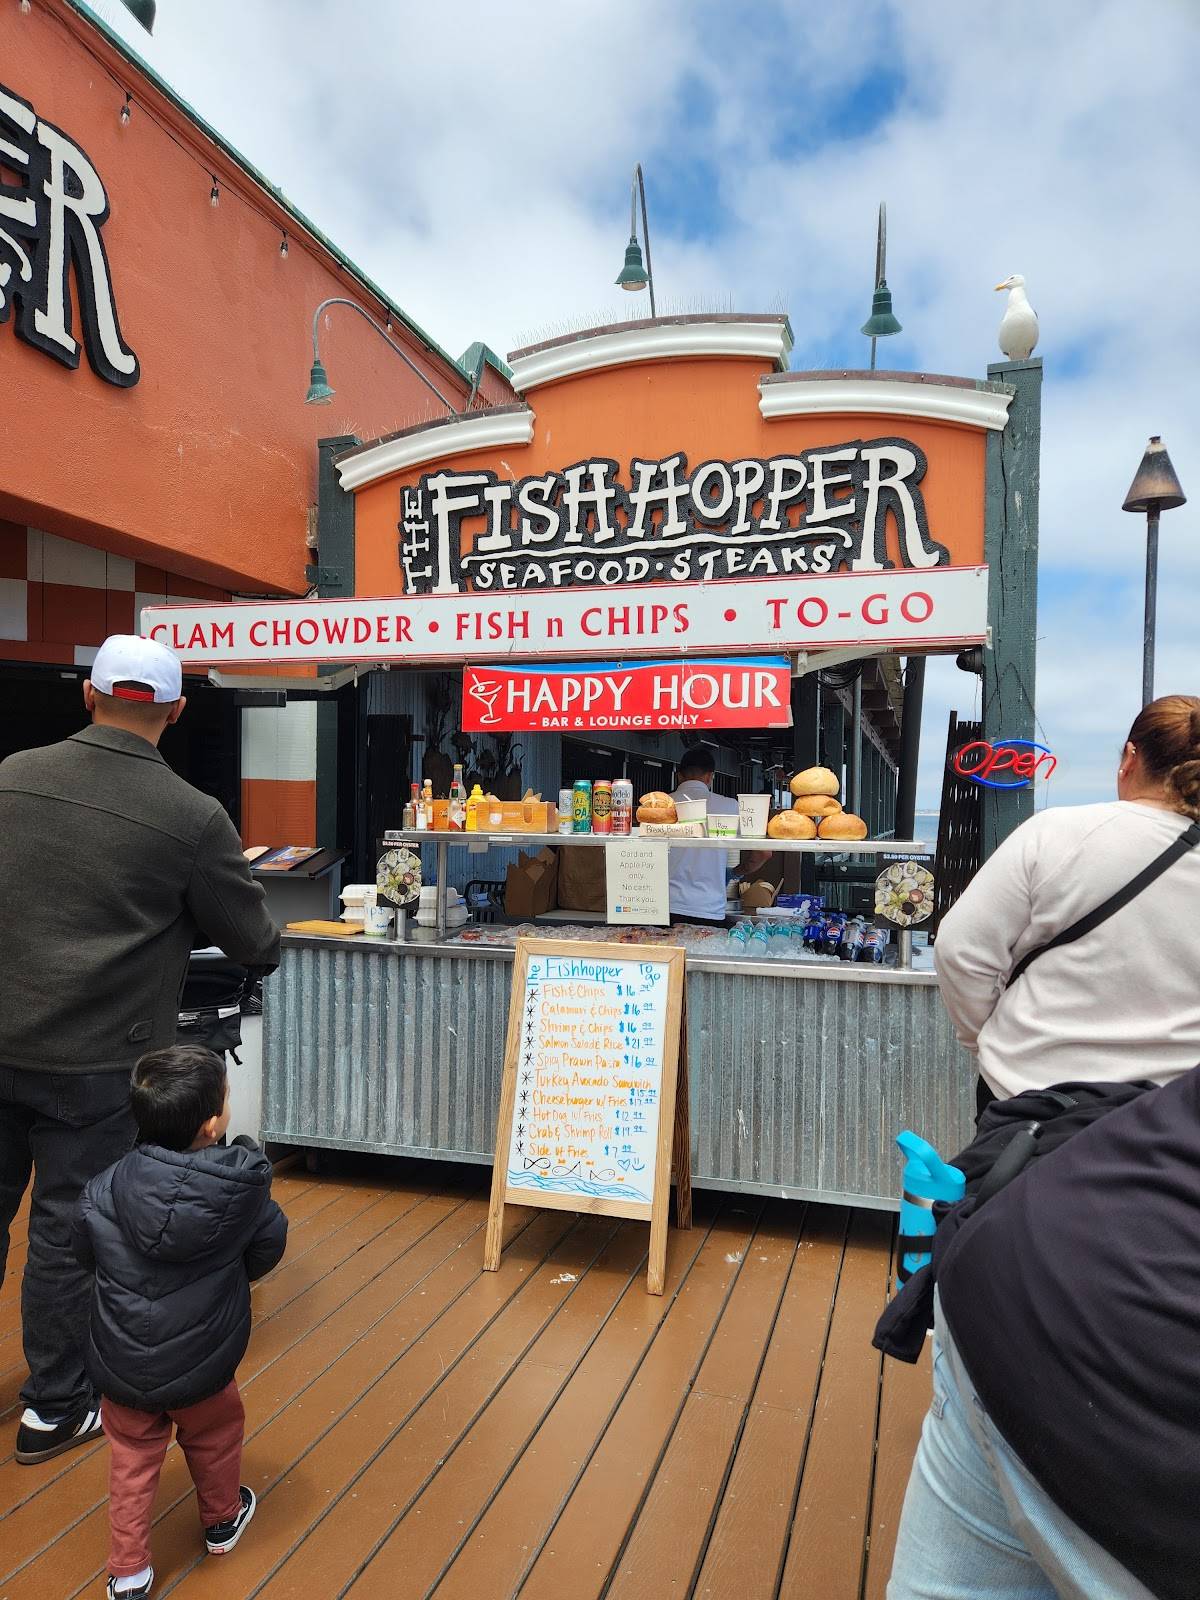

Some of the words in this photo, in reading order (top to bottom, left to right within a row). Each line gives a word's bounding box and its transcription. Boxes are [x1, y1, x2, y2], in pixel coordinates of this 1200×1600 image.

[402, 490, 432, 594] THE
[427, 464, 616, 593] FISH
[629, 446, 940, 571] HOPPER
[475, 556, 650, 588] SEAFOOD
[670, 544, 837, 581] STEAKS
[150, 622, 235, 649] CLAM
[249, 615, 413, 648] CHOWDER
[456, 610, 530, 641] FISH
[546, 617, 563, 638] n
[580, 603, 690, 636] CHIPS
[766, 592, 934, 629] TO-GO
[506, 676, 633, 713] HAPPY
[652, 672, 782, 710] HOUR
[542, 716, 569, 728] BAR
[574, 716, 584, 727] &
[589, 715, 651, 727] LOUNGE
[659, 713, 701, 725] ONLY
[954, 741, 1057, 780] Open
[619, 861, 640, 870] Apple
[641, 861, 655, 870] Pay
[620, 850, 638, 858] Card
[639, 850, 653, 858] and
[619, 894, 641, 903] Thank
[622, 883, 633, 891] No
[527, 964, 541, 986] The
[546, 958, 623, 983] Fishhopper
